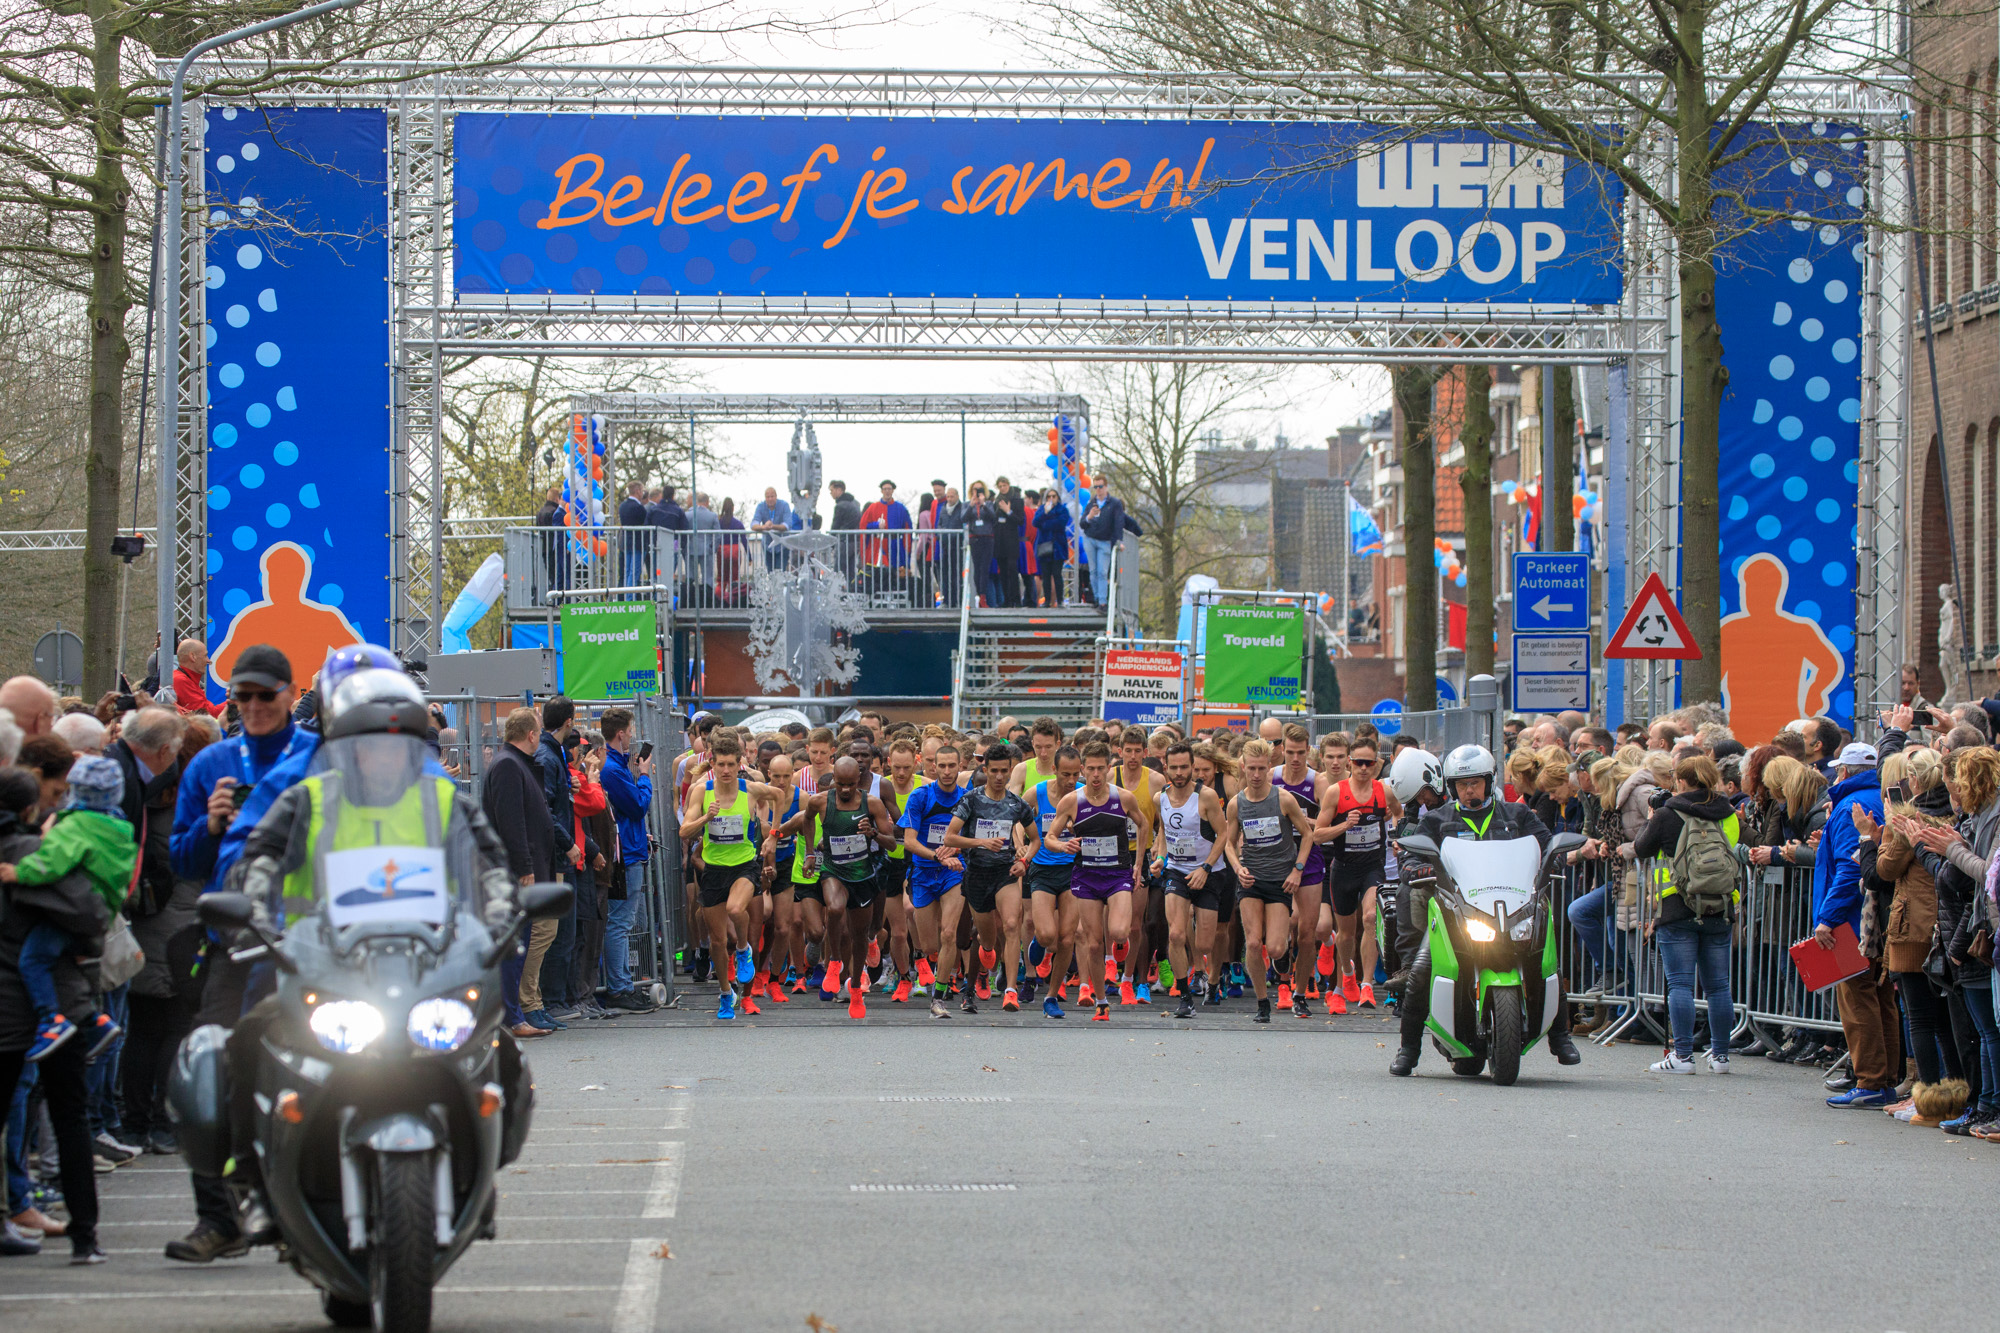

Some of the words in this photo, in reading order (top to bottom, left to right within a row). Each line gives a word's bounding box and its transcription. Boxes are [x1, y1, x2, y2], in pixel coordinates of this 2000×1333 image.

[536, 143, 839, 230] Beleef
[822, 145, 919, 249] je
[942, 137, 1215, 215] samen!
[1191, 217, 1566, 284] VENLOOP
[1526, 561, 1579, 573] Parkeer
[1519, 577, 1585, 588] Automaat
[570, 605, 626, 616] STARTVAK
[628, 605, 646, 613] HM
[1217, 608, 1274, 618] STARTVAK
[1276, 610, 1295, 619] HM
[578, 629, 639, 645] Topveld
[1223, 634, 1285, 648] Topveld
[1531, 641, 1550, 649] gebied
[1558, 641, 1583, 649] beveiligd
[1117, 656, 1172, 665] NEDERLANDS
[1108, 663, 1181, 672] KAMPIOENSCHAP
[605, 679, 656, 690] VENLOOP
[1123, 679, 1163, 688] HALVE
[1107, 689, 1179, 700] MARATHON
[1246, 686, 1298, 696] VENLOOP
[721, 826, 727, 834] 7
[986, 831, 1000, 839] 111
[846, 845, 851, 853] 4
[1096, 847, 1101, 855] 1
